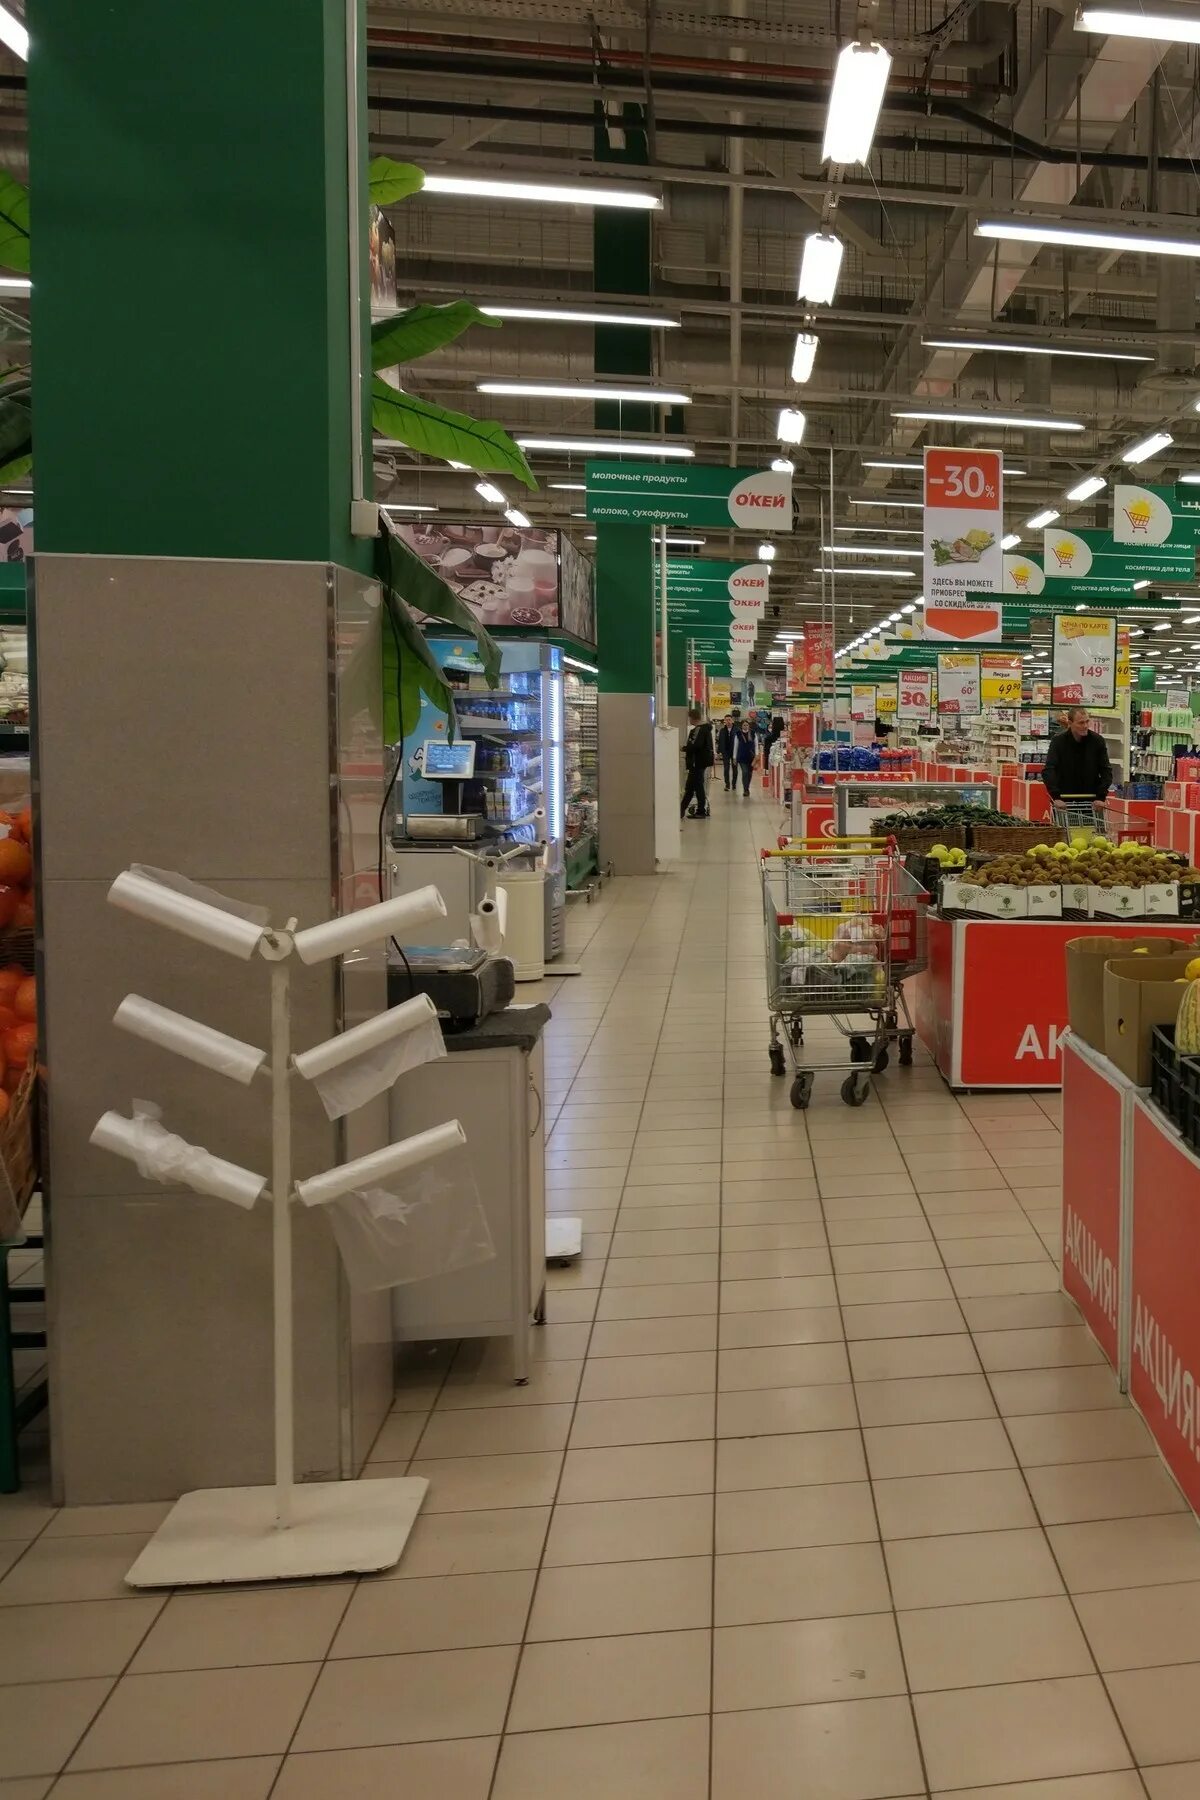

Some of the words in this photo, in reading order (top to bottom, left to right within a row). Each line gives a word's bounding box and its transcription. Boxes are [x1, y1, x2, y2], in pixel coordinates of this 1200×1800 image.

[592, 472, 640, 482] молочные
[642, 474, 688, 484] продукты
[592, 507, 630, 516] молоко,
[632, 509, 689, 519] сухофрукты
[1125, 564, 1160, 572] косметика
[932, 578, 953, 587] ЗДЕСЬ
[954, 579, 966, 587] ВЫ
[966, 579, 994, 588] МОЖЕТЕ
[1071, 584, 1097, 592] средства
[1098, 585, 1109, 593] для
[1110, 585, 1132, 593] бритья
[934, 599, 944, 608] СО
[901, 691, 930, 707] 30%
[1062, 690, 1082, 698] 16%
[1064, 1203, 1117, 1330] АКЦИЯ!
[1133, 1294, 1200, 1464] АКЦИЯ!
